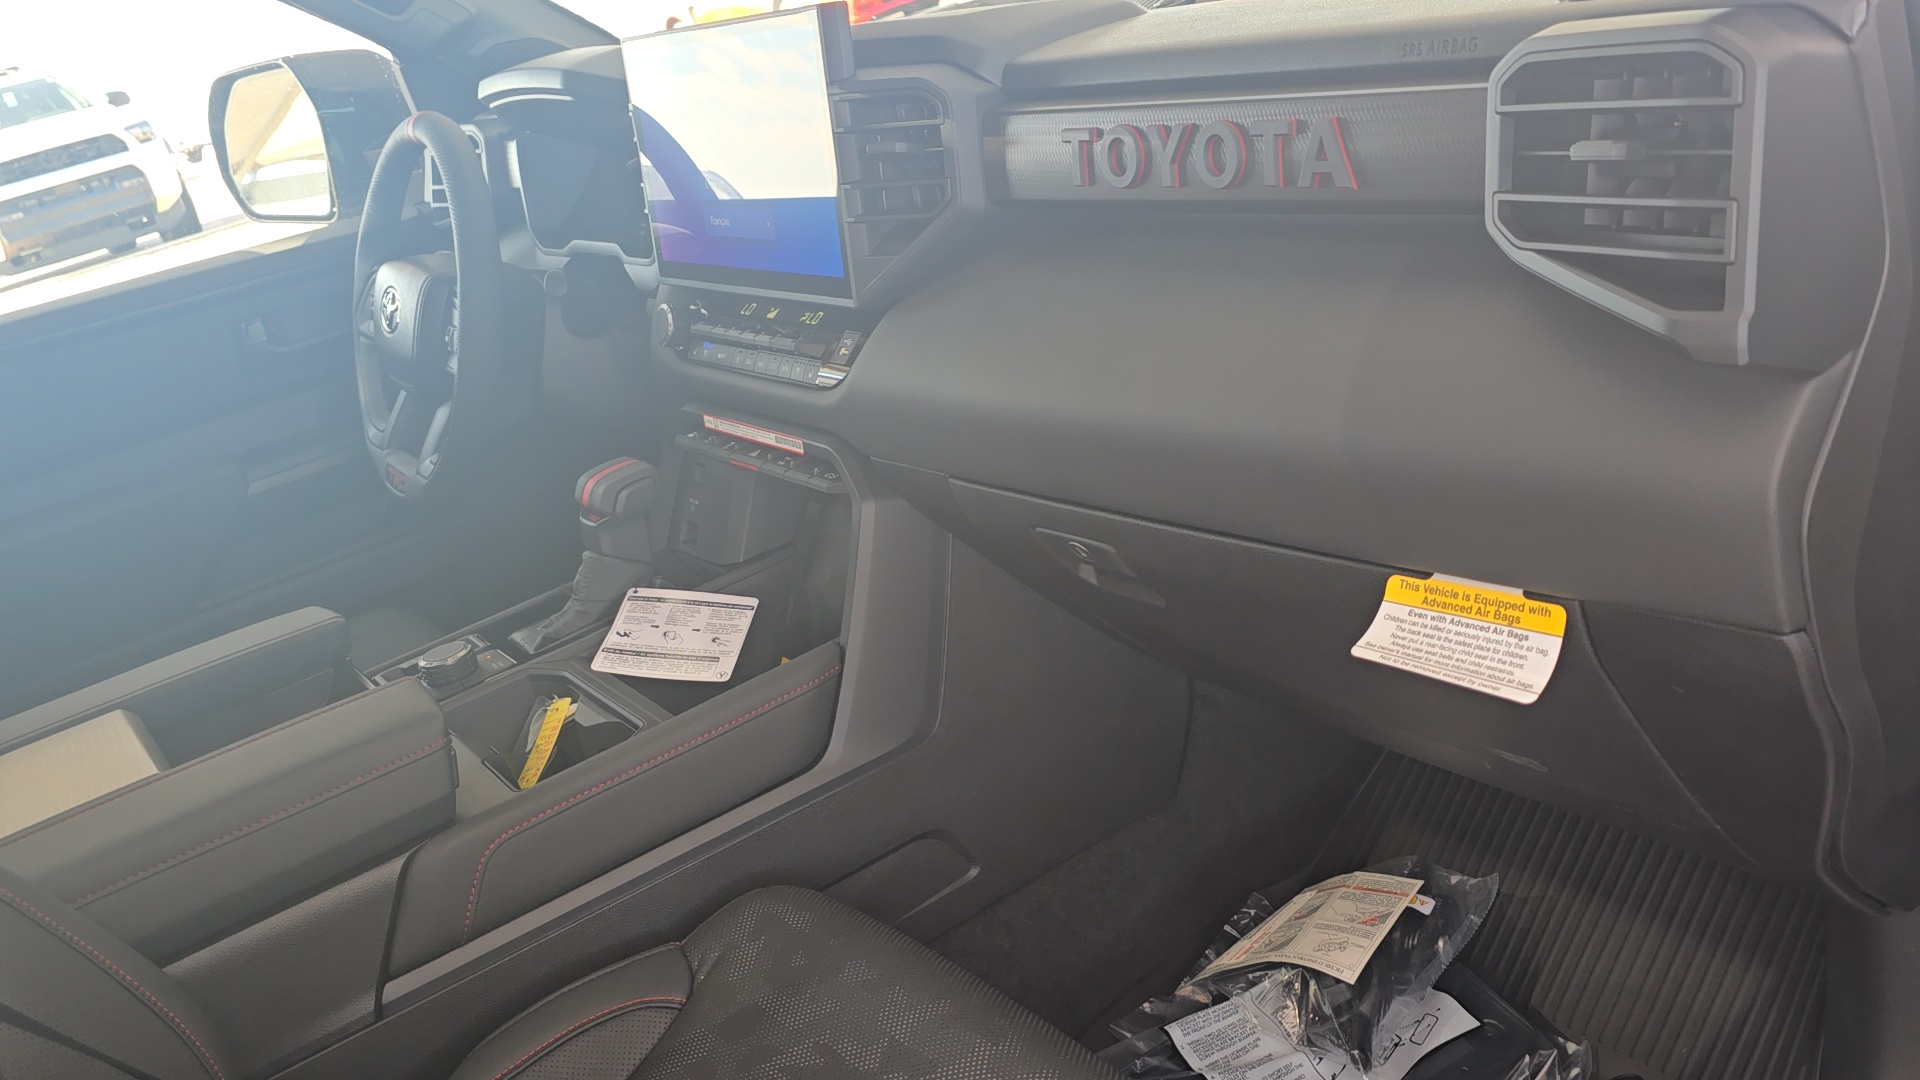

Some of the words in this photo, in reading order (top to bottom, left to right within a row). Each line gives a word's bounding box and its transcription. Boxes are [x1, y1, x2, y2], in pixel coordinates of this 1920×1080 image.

[1402, 43, 1423, 57] SRS
[1427, 37, 1478, 55] AIRBAG
[1061, 115, 1358, 189] TOYOTA
[710, 216, 730, 228] Français
[1400, 579, 1420, 592] This
[1423, 583, 1459, 600] Vehicle
[1462, 591, 1471, 602] is
[1474, 594, 1526, 613] Equipped
[1528, 605, 1552, 618] with
[1421, 596, 1473, 614] Advanced
[1475, 606, 1490, 618] Air
[1493, 610, 1521, 625] Bags
[1383, 613, 1408, 624] Children
[1429, 623, 1445, 633] killed
[1453, 630, 1480, 643] seriously
[1481, 635, 1504, 646] injured
[1395, 625, 1406, 633] The
[1406, 627, 1421, 636] back
[1473, 642, 1491, 653] place
[1407, 609, 1428, 620] Even
[1430, 615, 1447, 624] with
[1448, 618, 1490, 633] Advanced
[1492, 627, 1505, 636] Air
[1507, 630, 1529, 642] Bags
